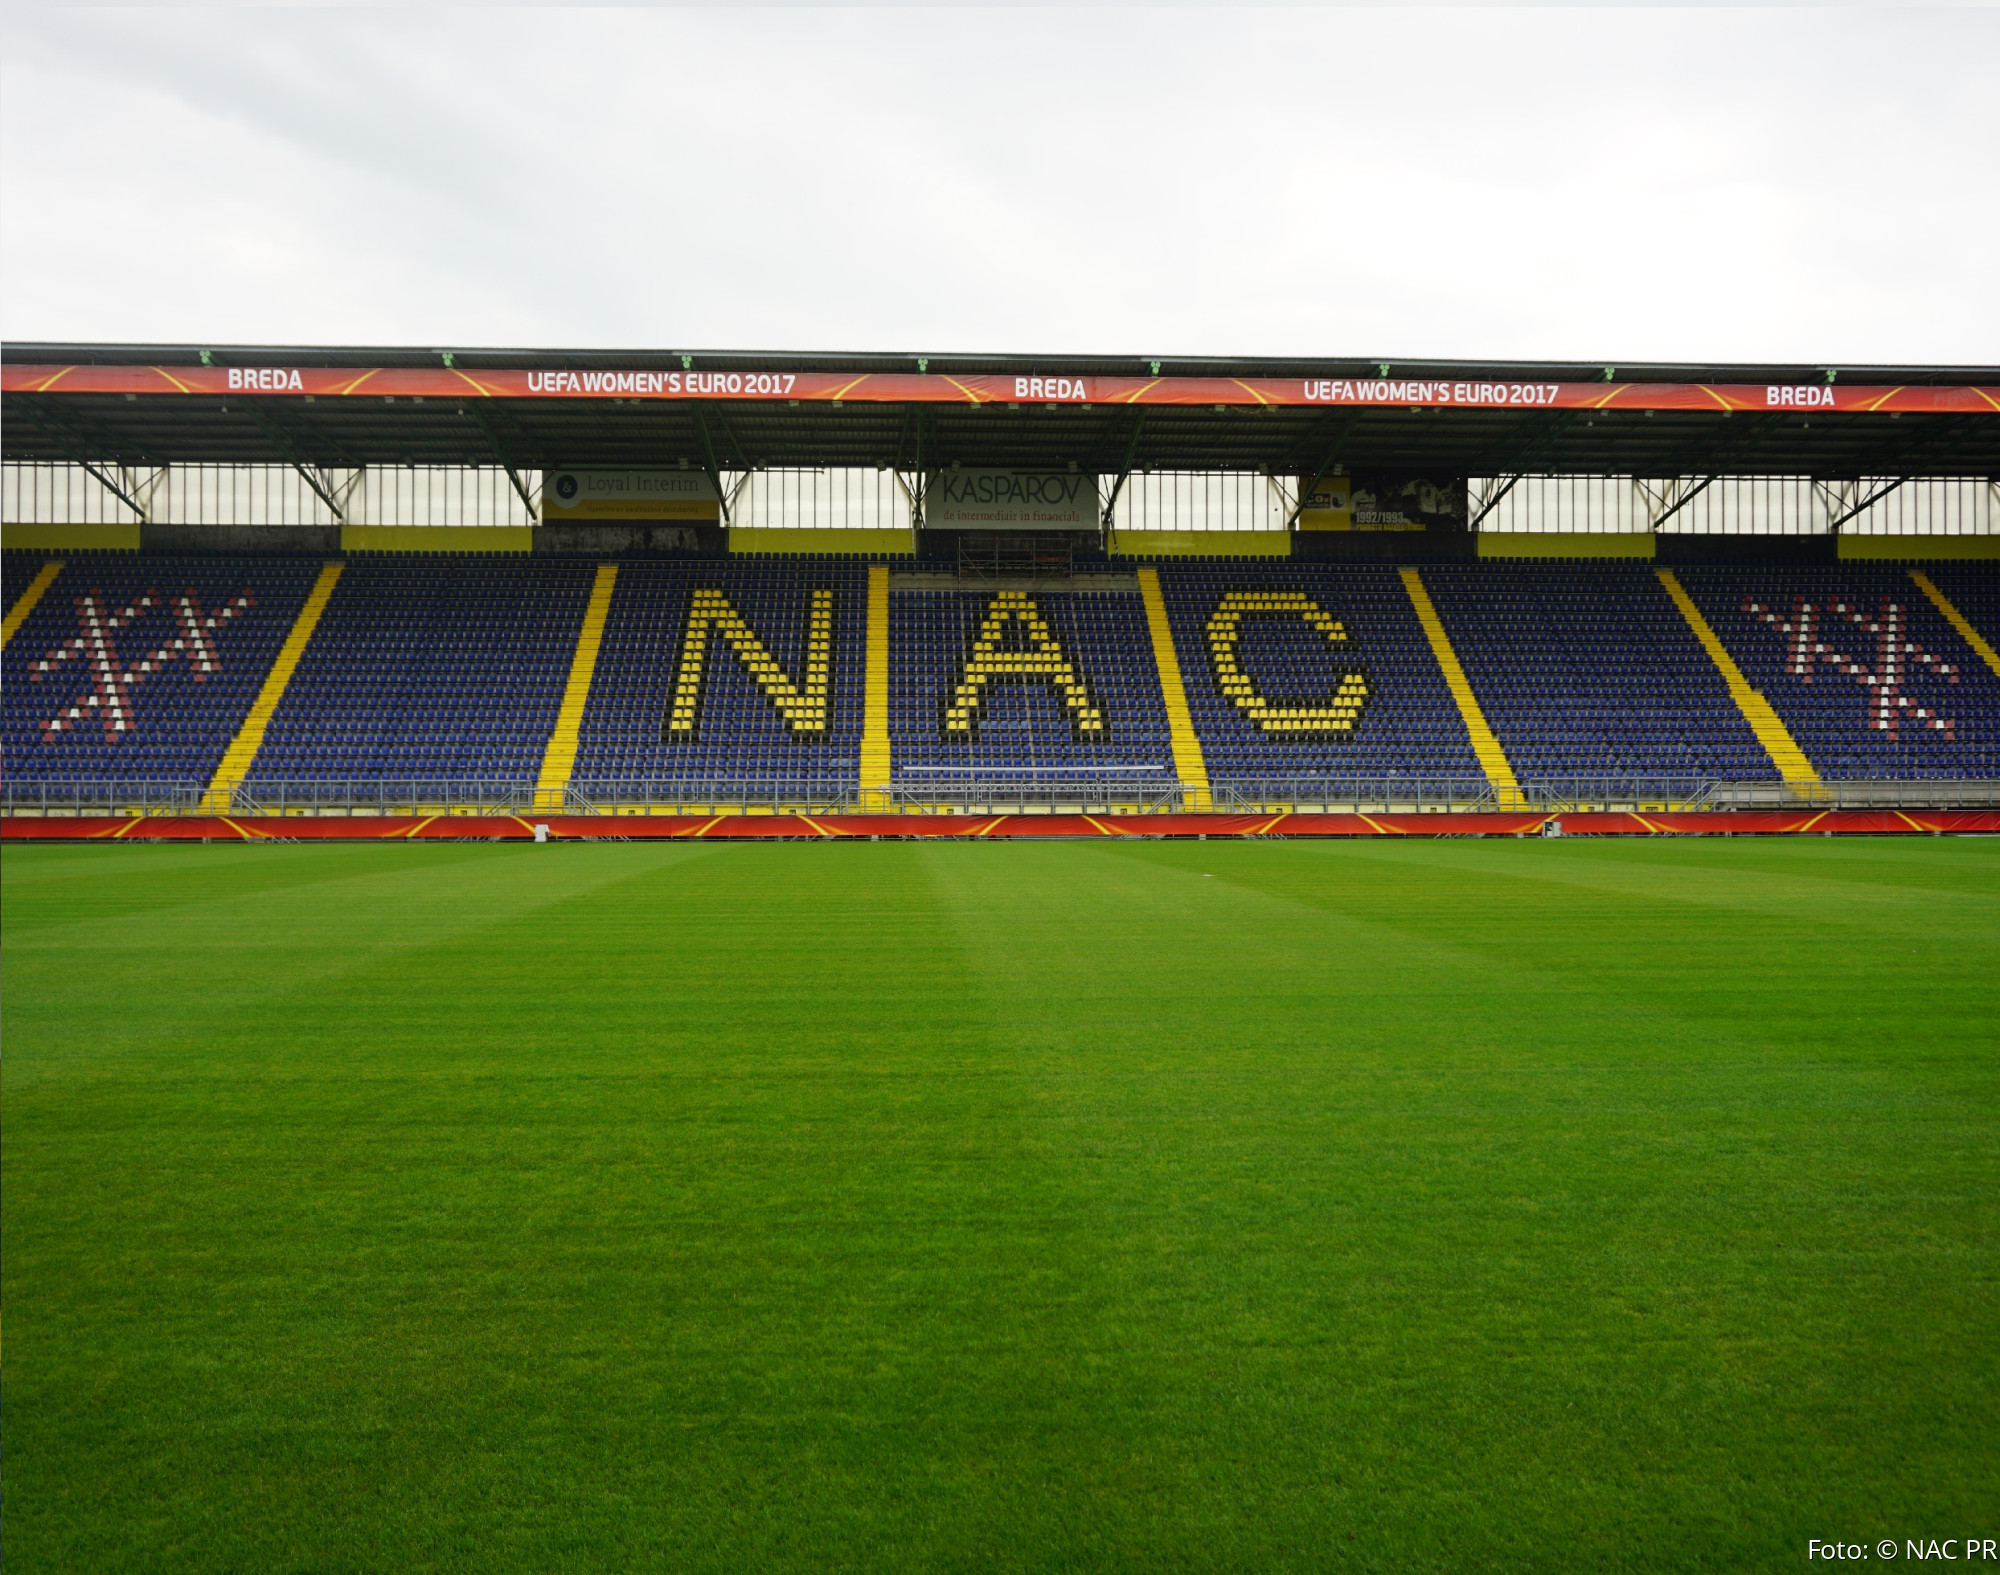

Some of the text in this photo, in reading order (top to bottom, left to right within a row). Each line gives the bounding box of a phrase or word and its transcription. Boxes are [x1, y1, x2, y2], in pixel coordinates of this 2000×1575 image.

[228, 368, 303, 390] BREDA
[527, 372, 796, 394] UEFA WOMEN'S EURO 2017
[1015, 377, 1087, 400] BREDA
[1304, 380, 1559, 404] UEFA WOMEN'S EURO 2017
[1766, 386, 1836, 407] BREDA
[587, 475, 699, 495] Loyal Interim
[943, 475, 1081, 504] KASPAROV
[943, 510, 1081, 522] de intermediair in financials
[1356, 511, 1404, 524] 1992/1993
[669, 588, 1371, 733] NAC
